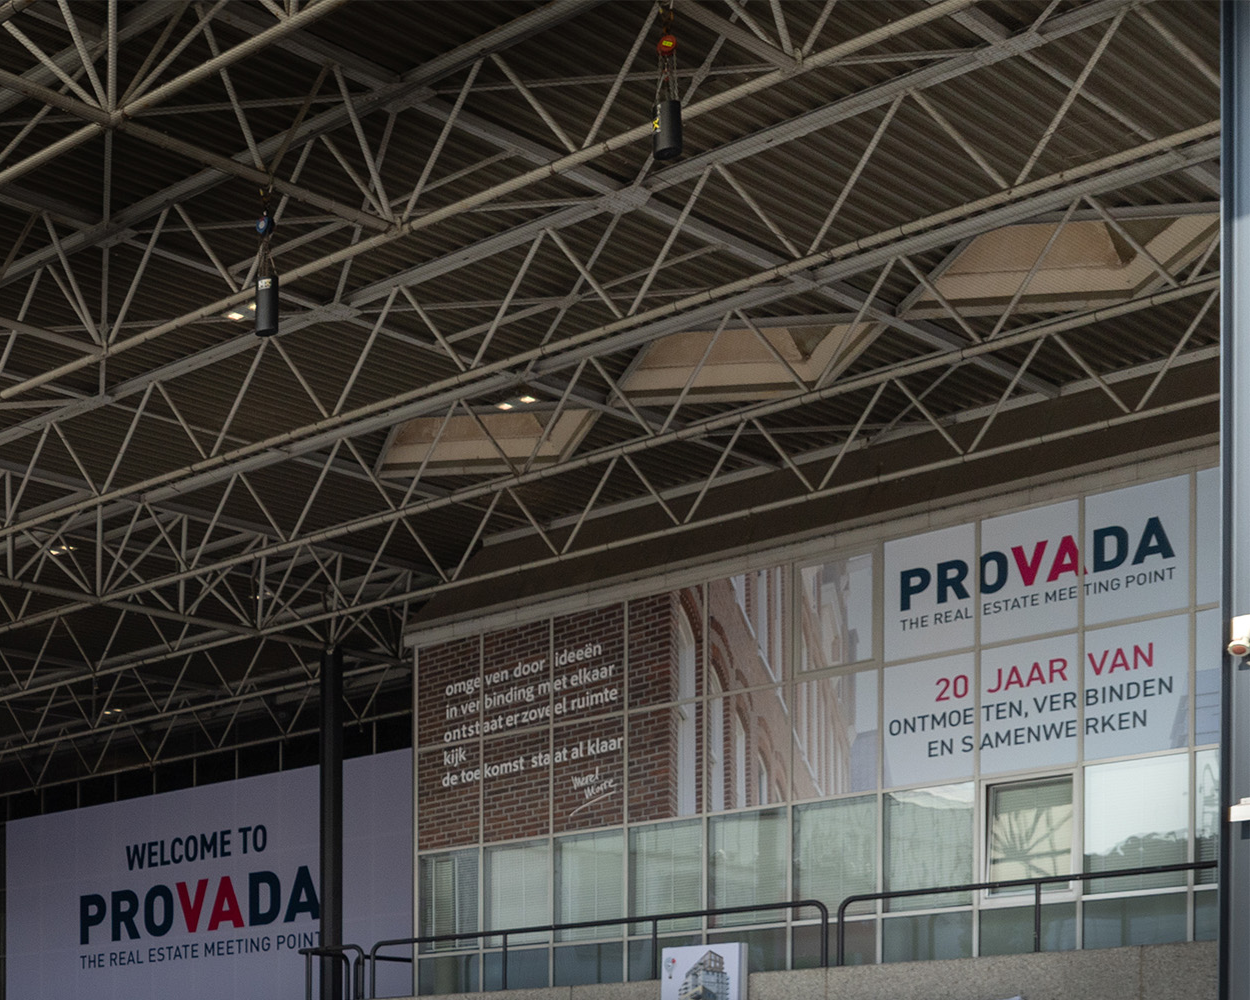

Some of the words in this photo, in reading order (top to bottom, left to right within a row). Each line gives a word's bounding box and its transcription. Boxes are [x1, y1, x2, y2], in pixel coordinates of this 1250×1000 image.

[900, 516, 1176, 612] PROVADA
[901, 615, 928, 631] THE
[934, 607, 973, 625] REAL
[983, 593, 1040, 616] ESTATE
[1045, 578, 1121, 604] MEETING
[1125, 567, 1176, 589] POINT
[514, 660, 545, 678] door
[555, 643, 602, 667] ideeën
[935, 674, 969, 702] 20
[987, 657, 1068, 694] JAAR
[1088, 642, 1154, 676] VAN
[446, 705, 458, 719] in
[538, 675, 567, 695] met
[571, 664, 615, 686] elkaar
[506, 713, 520, 727] er
[571, 688, 618, 711] ruimte
[442, 772, 458, 787] de
[571, 741, 584, 760] al
[588, 737, 624, 755] klaar
[444, 747, 467, 767] kijk
[928, 739, 953, 758] EN
[126, 829, 231, 871] WELCOME
[239, 824, 267, 855] TO
[80, 865, 320, 945] PROVADA
[80, 953, 105, 970] THE
[109, 948, 144, 967] REAL
[149, 943, 199, 963] ESTATE
[204, 936, 271, 958] MEETING
